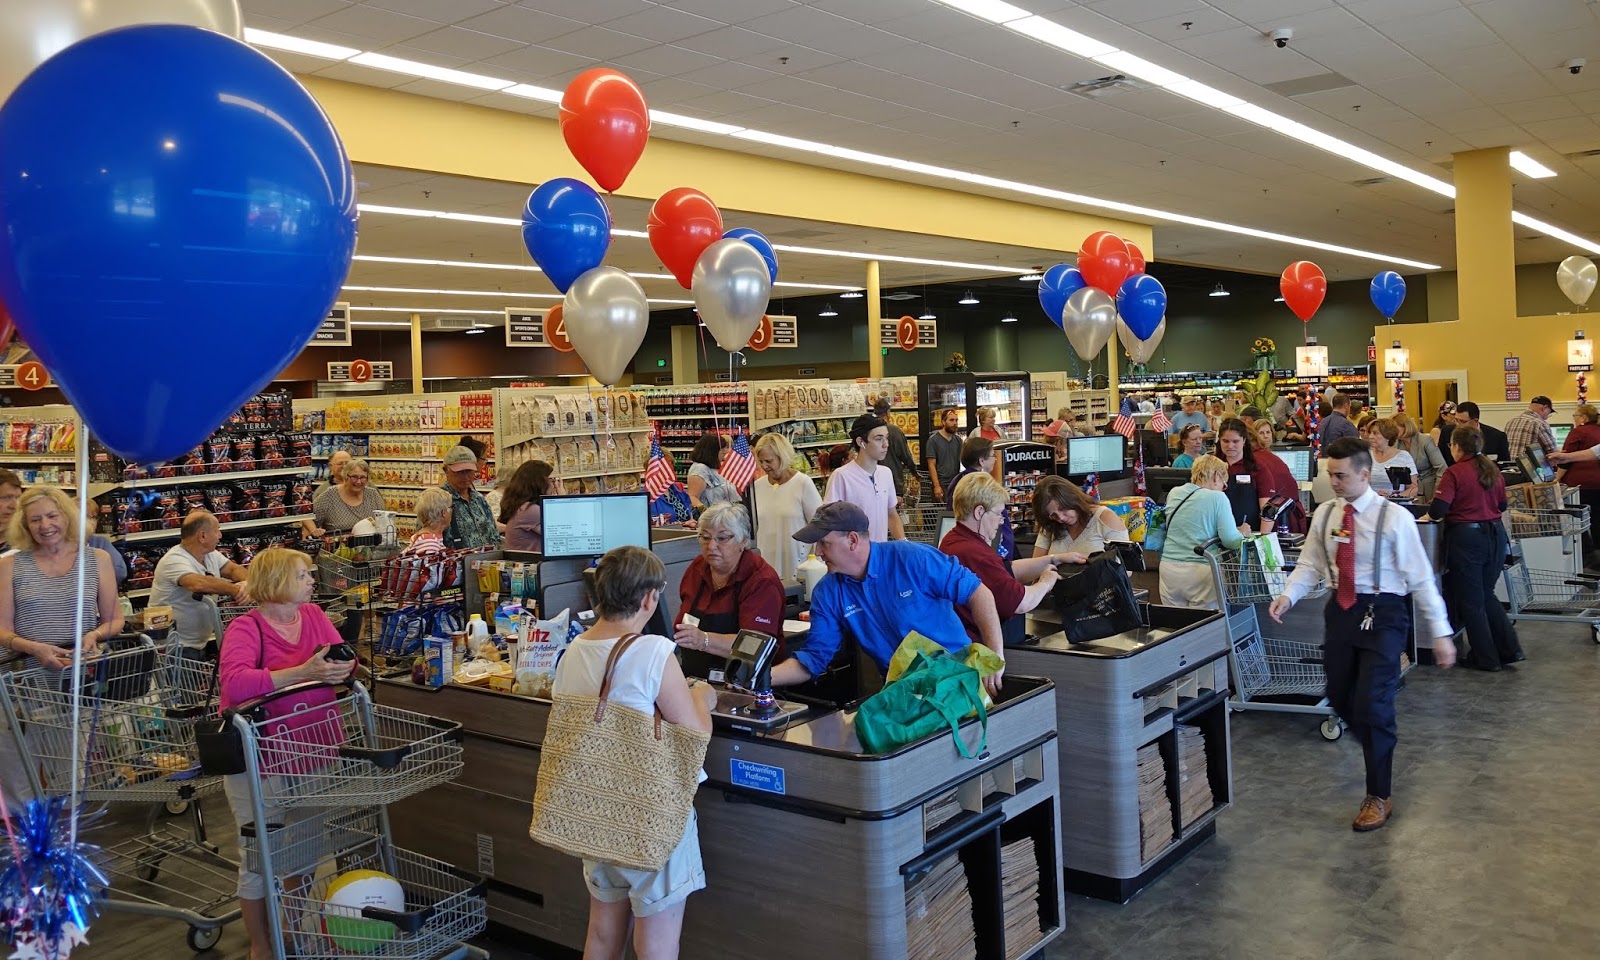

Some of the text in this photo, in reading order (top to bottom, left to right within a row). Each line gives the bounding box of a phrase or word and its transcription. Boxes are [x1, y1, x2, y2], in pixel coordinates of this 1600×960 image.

[555, 317, 571, 343] 4
[753, 319, 765, 344] 3
[903, 322, 914, 344] 2
[24, 366, 40, 385] 4
[356, 363, 367, 379] 2
[243, 422, 273, 430] TERRA
[291, 433, 312, 441] TERRA
[1006, 450, 1051, 462] DURACELL
[538, 644, 558, 652] Added
[738, 762, 777, 777] Checkwriting
[745, 771, 771, 783] Platform
